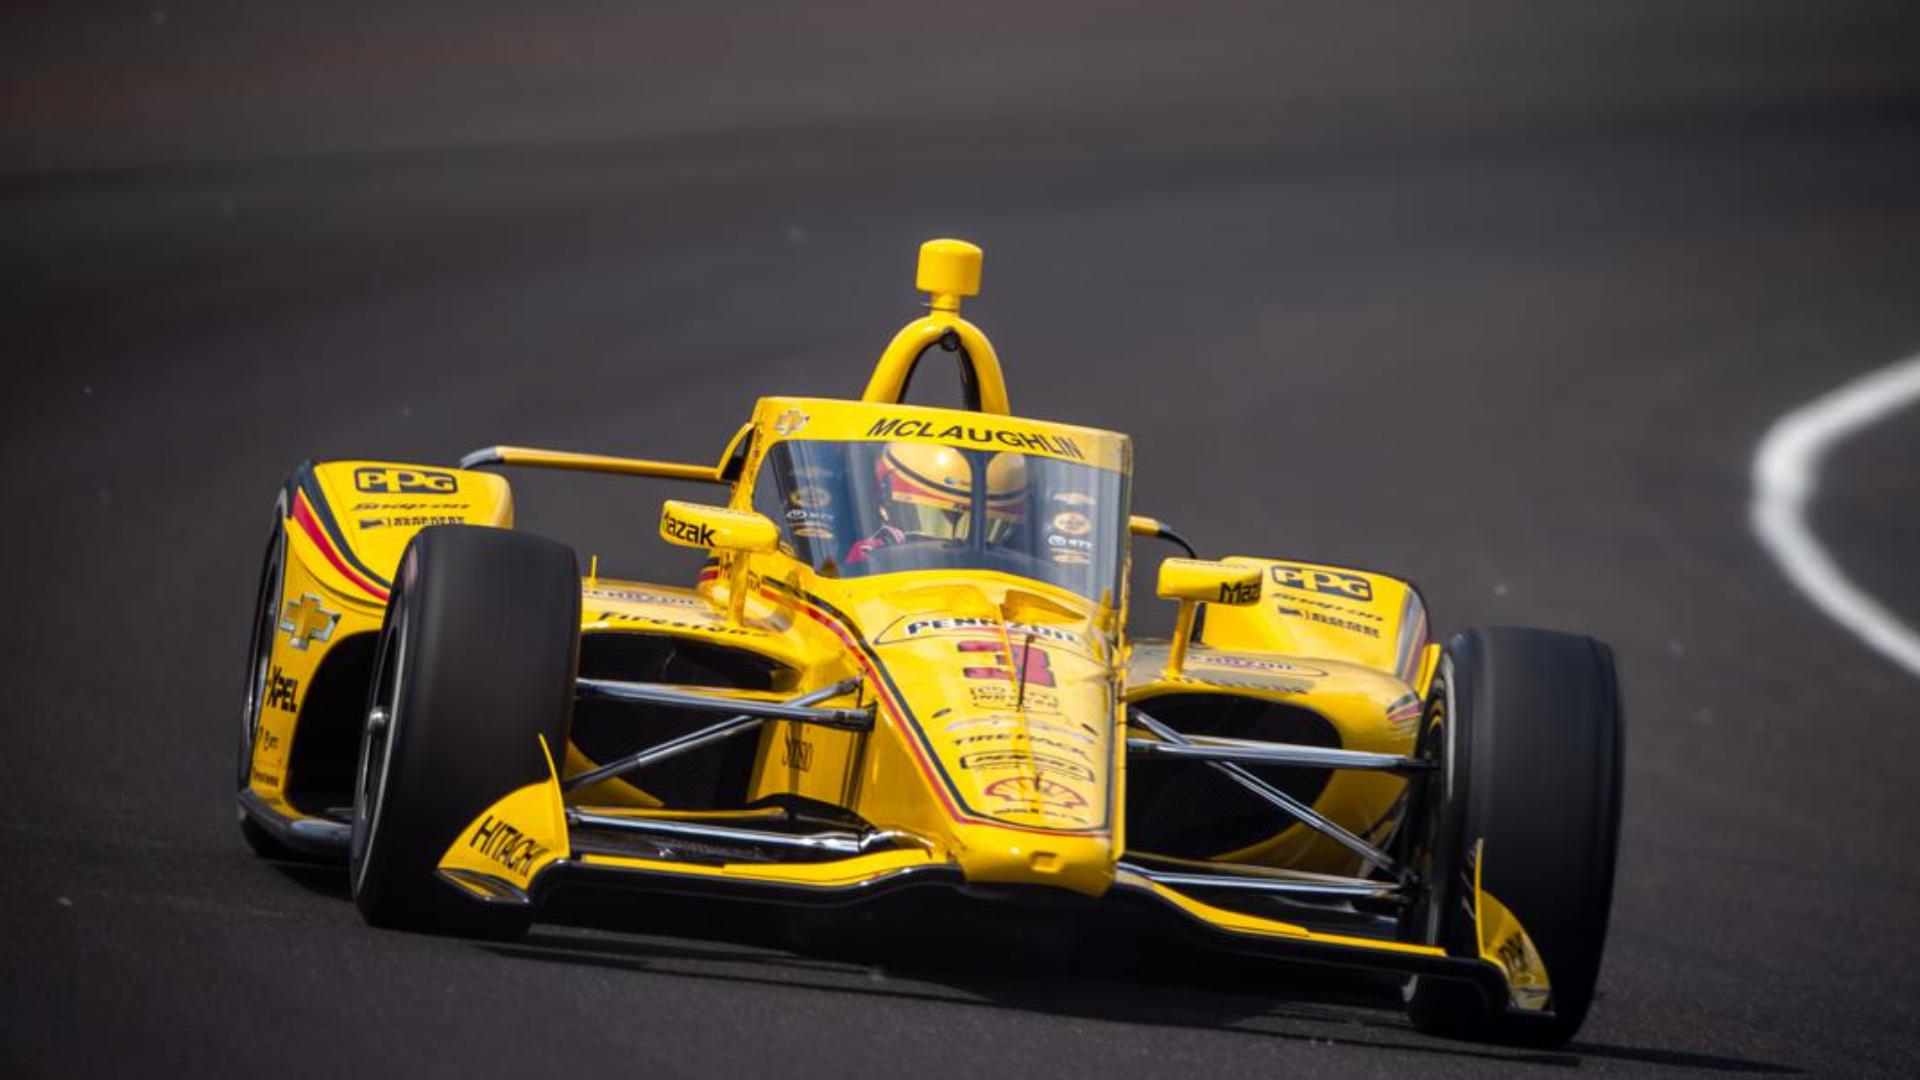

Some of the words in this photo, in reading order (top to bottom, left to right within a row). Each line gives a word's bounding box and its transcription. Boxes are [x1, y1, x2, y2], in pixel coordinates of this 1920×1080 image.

[866, 418, 1085, 460] MCLAUGHLIN
[356, 468, 456, 493] PPG
[1273, 566, 1371, 600] PPG
[957, 639, 1056, 688] 3
